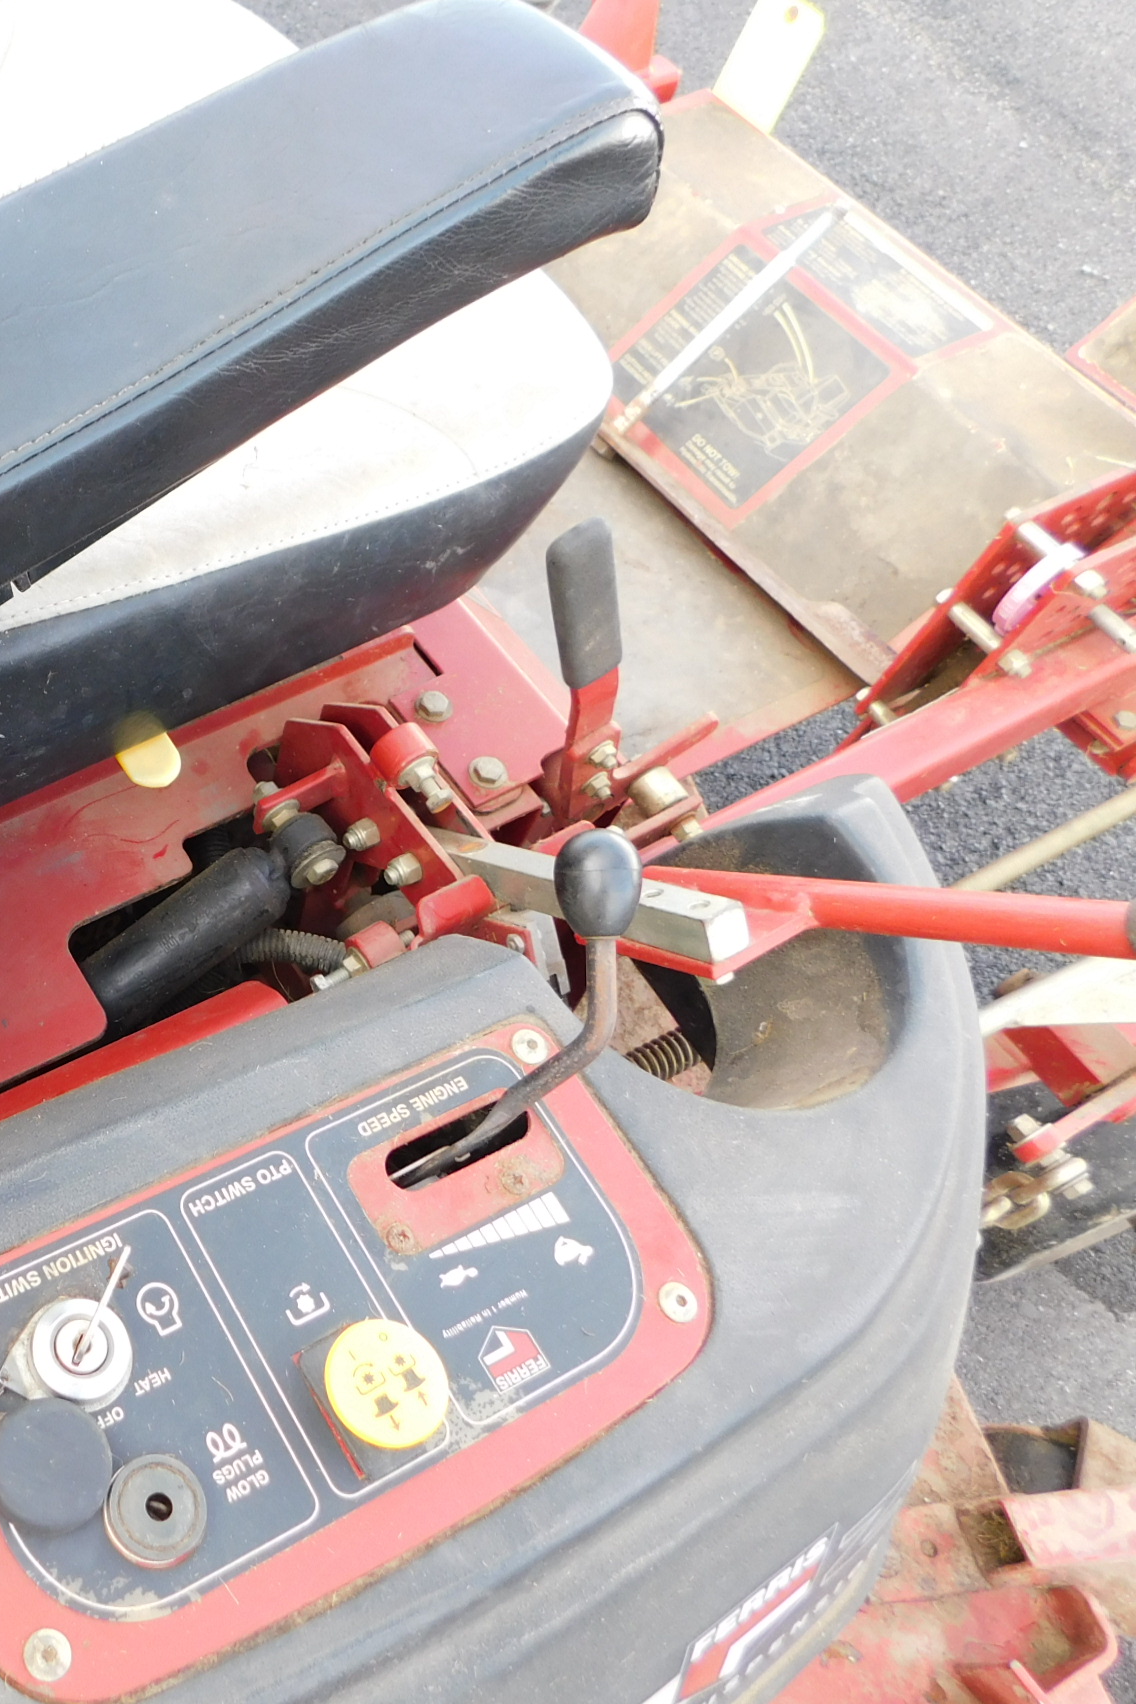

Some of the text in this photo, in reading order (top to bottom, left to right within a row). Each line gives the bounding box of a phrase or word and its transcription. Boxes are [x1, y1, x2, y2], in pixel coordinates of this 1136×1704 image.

[692, 433, 706, 447] DO
[704, 444, 722, 462] NOT
[719, 458, 740, 478] TOW!
[357, 1076, 469, 1137] ENGINE SPEED
[188, 1158, 294, 1217] PTO SWITCH
[42, 1232, 123, 1281] IGNITION
[497, 1289, 528, 1309] Number
[442, 1313, 483, 1338] Reliability
[133, 1367, 172, 1396] HEAT
[495, 1354, 548, 1391] FERRIS
[97, 1406, 125, 1430] OFF
[212, 1449, 264, 1485] PLUGS
[226, 1469, 270, 1503] GLOW
[690, 1536, 828, 1662] FERRIS
